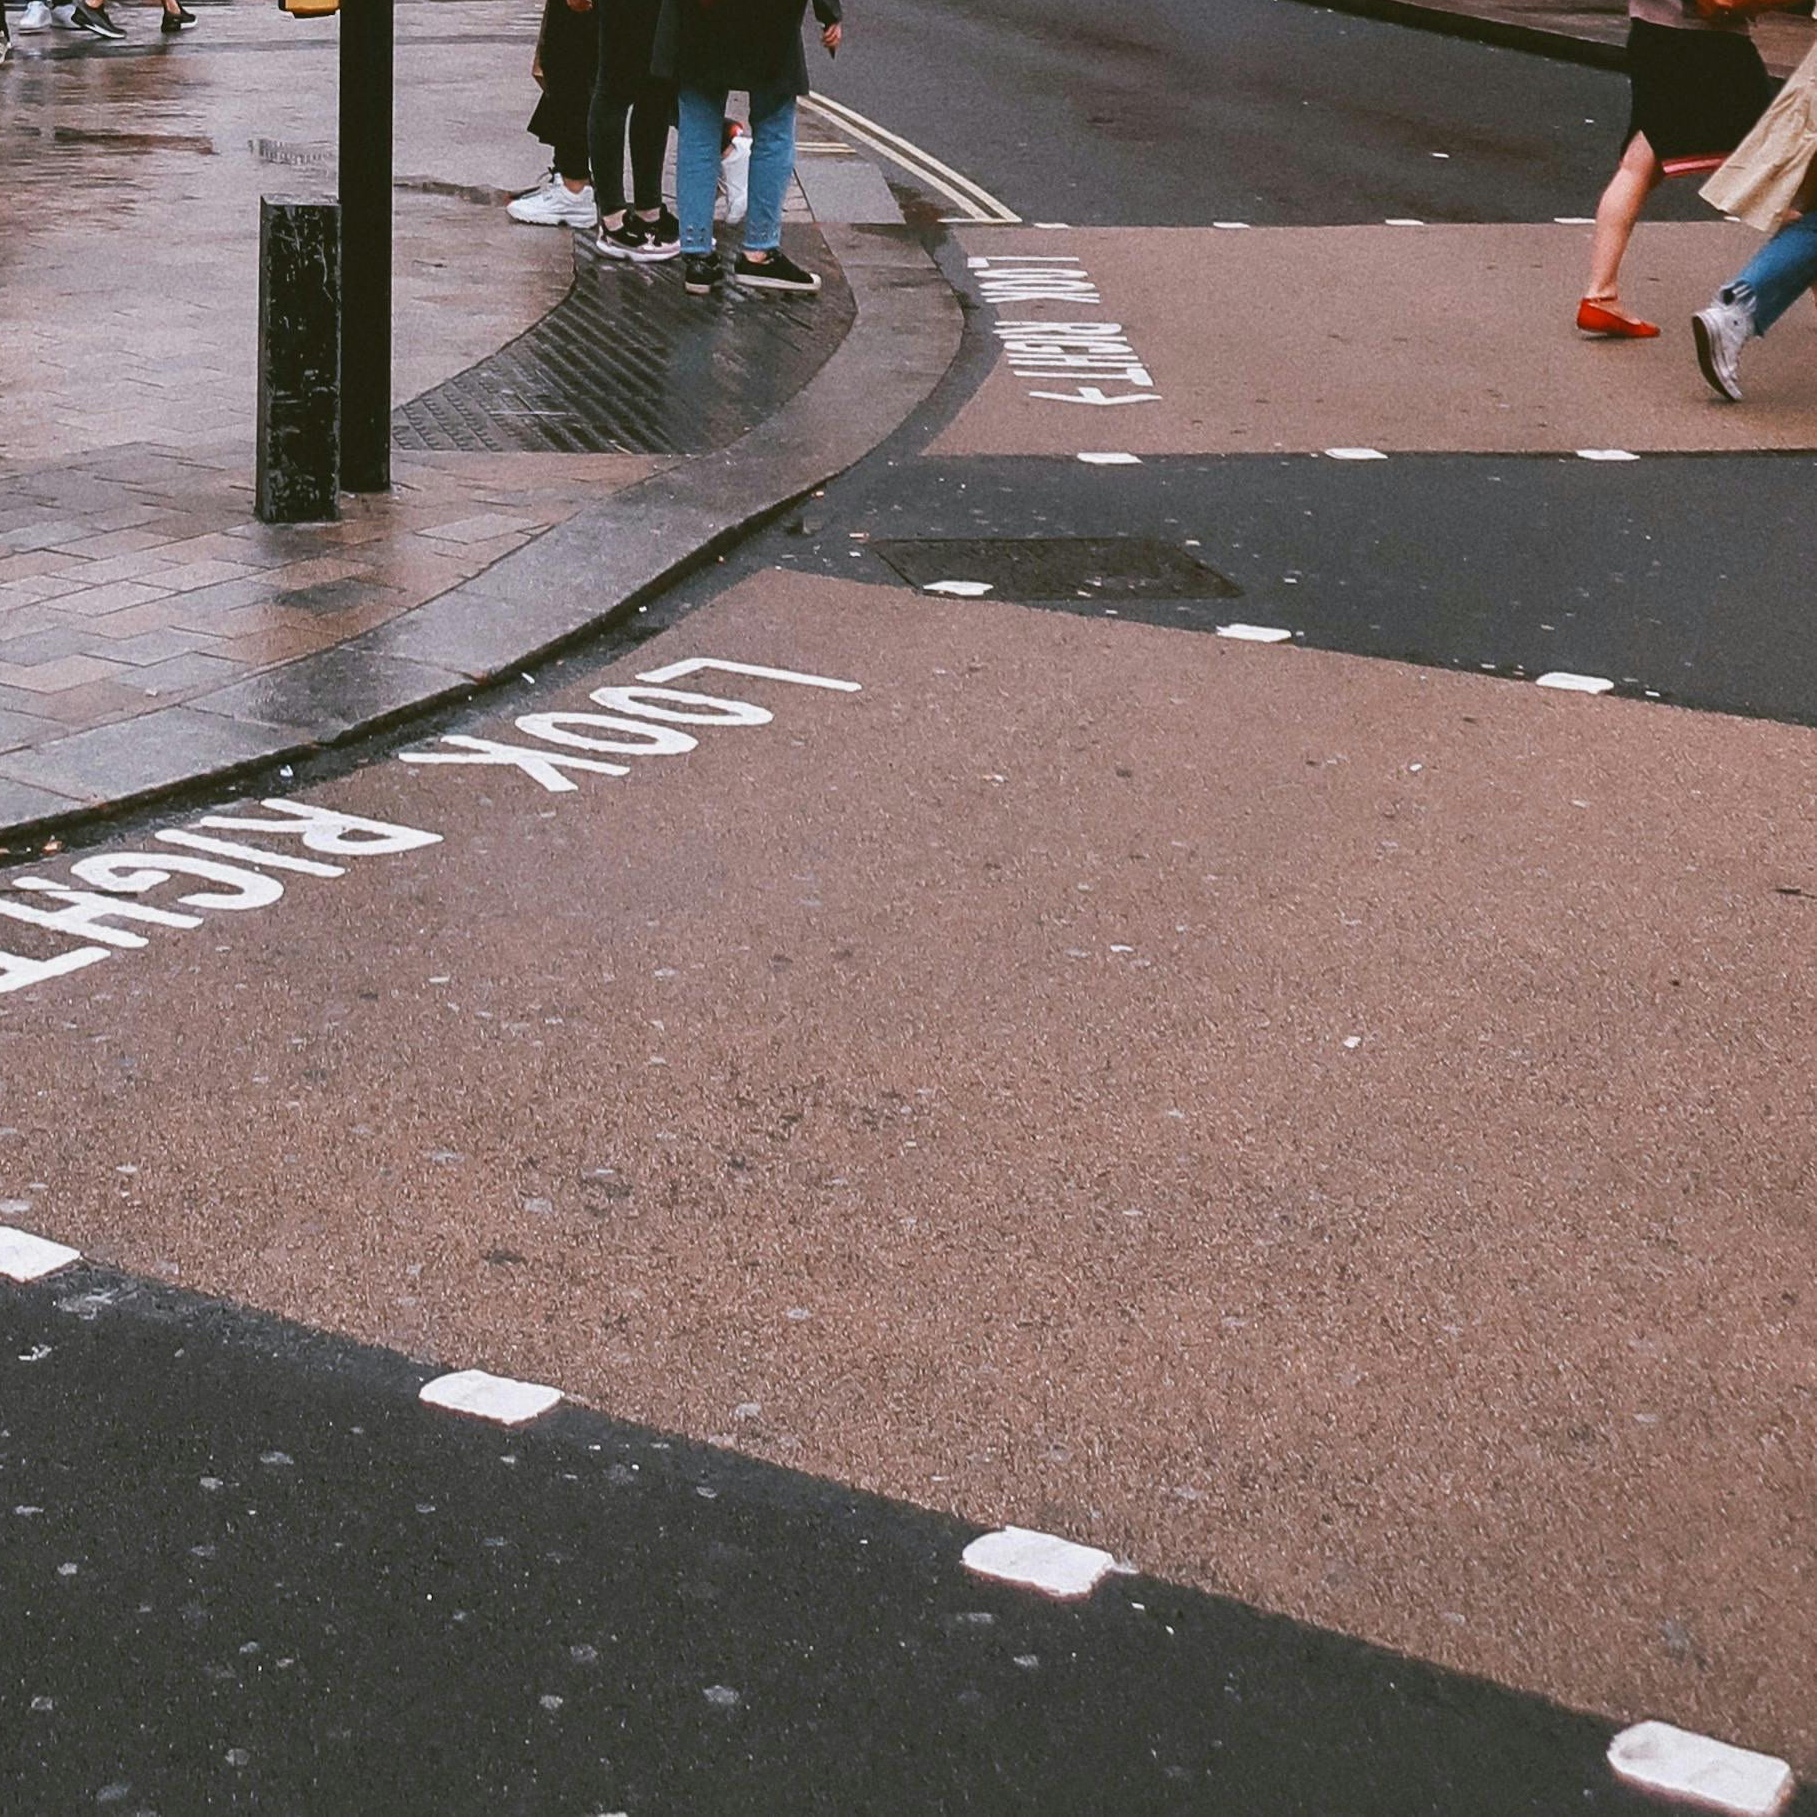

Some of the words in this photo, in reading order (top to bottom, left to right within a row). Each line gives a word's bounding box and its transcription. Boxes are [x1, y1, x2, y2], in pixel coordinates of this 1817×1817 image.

[967, 255, 1101, 304] LOOK
[991, 320, 1154, 387] RIGHT
[399, 658, 861, 792] LOOK
